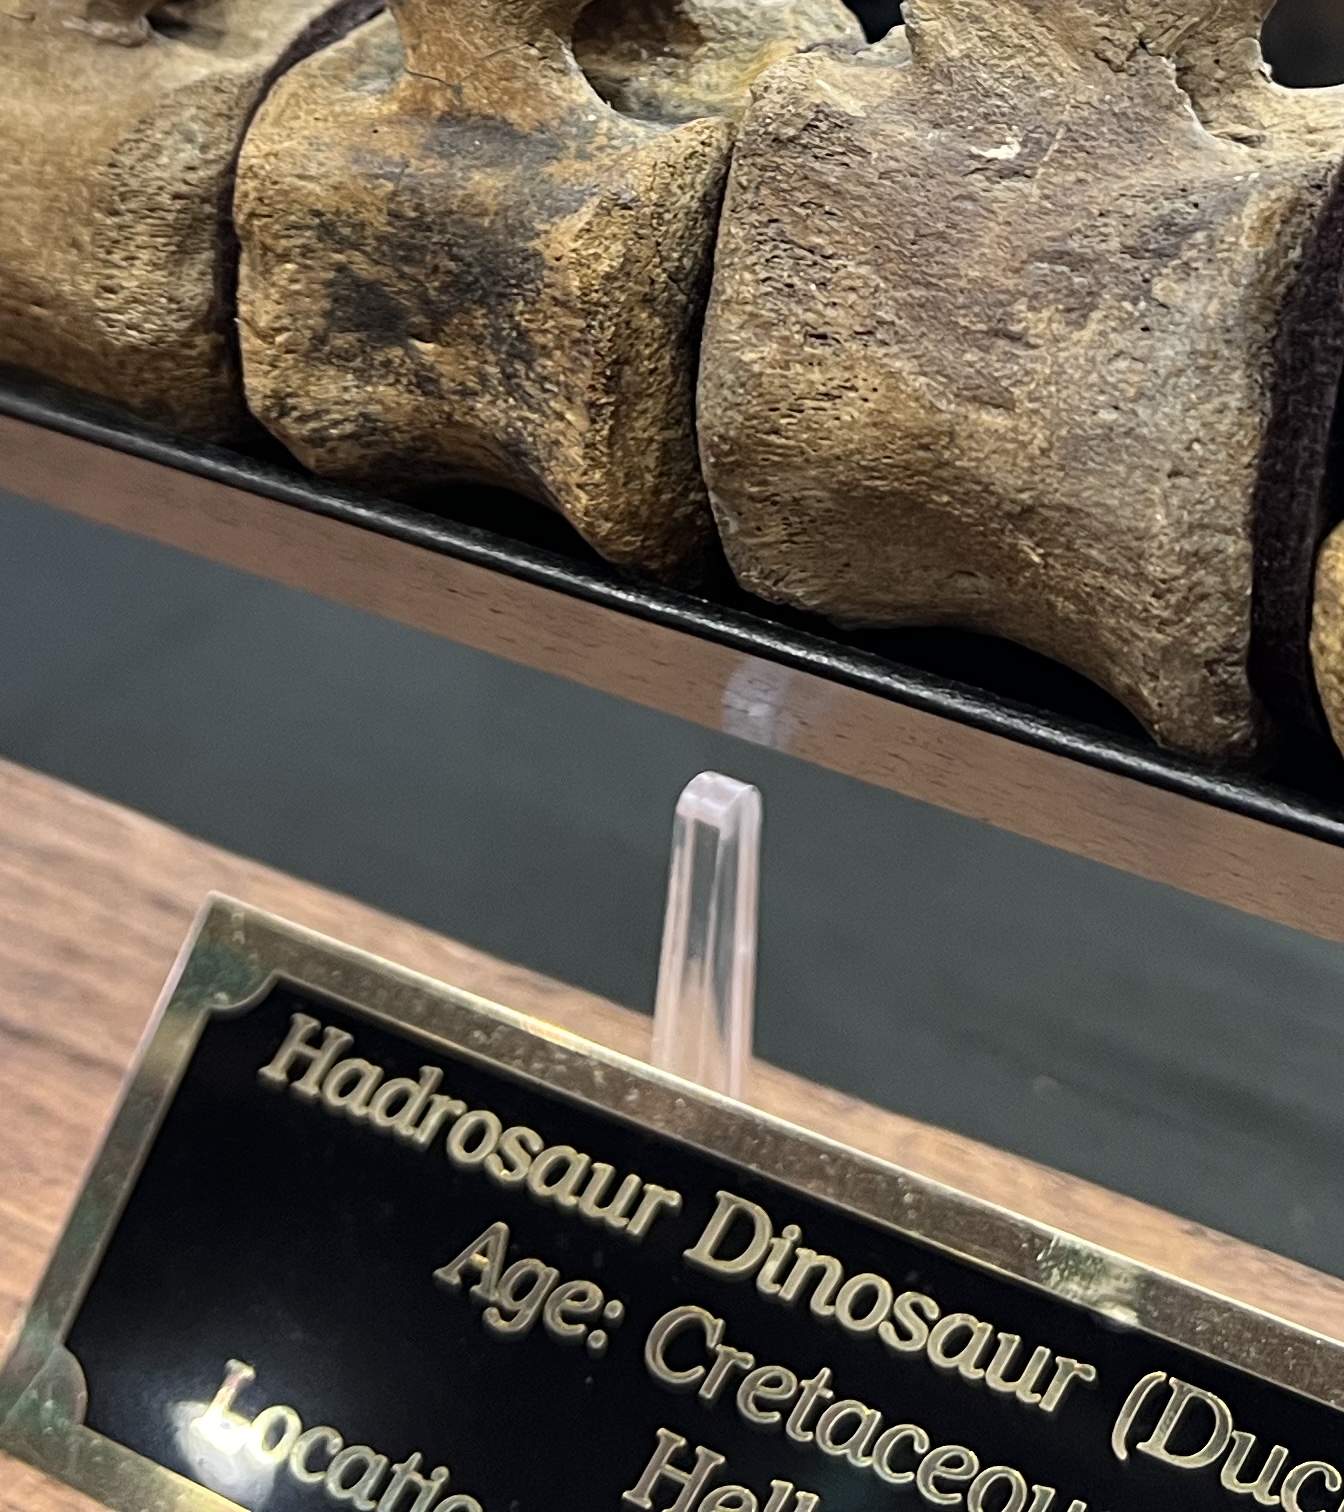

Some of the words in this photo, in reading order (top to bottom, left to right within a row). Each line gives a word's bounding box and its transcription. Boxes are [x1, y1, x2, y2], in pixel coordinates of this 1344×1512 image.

[258, 1012, 682, 1238] Hadrosaur
[682, 1189, 1097, 1412] Dinosaur
[432, 1221, 624, 1355] Age:
